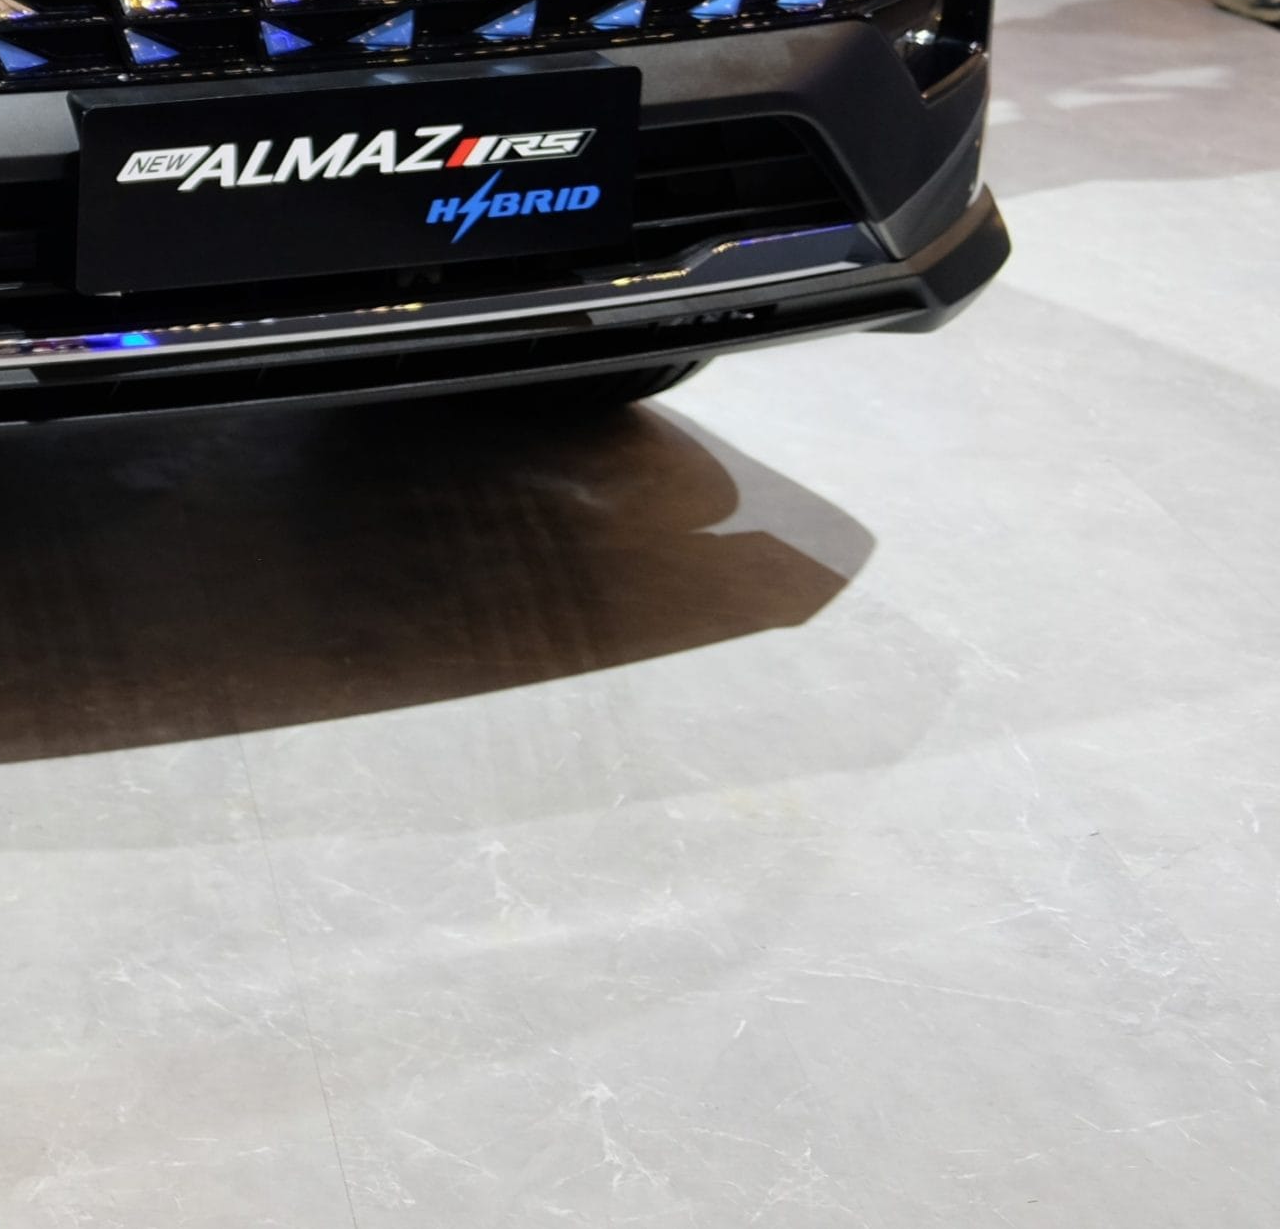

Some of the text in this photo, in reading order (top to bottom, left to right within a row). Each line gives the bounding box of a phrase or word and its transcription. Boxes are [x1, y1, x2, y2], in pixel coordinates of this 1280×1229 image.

[129, 125, 581, 191] NEW ALMAZ RS
